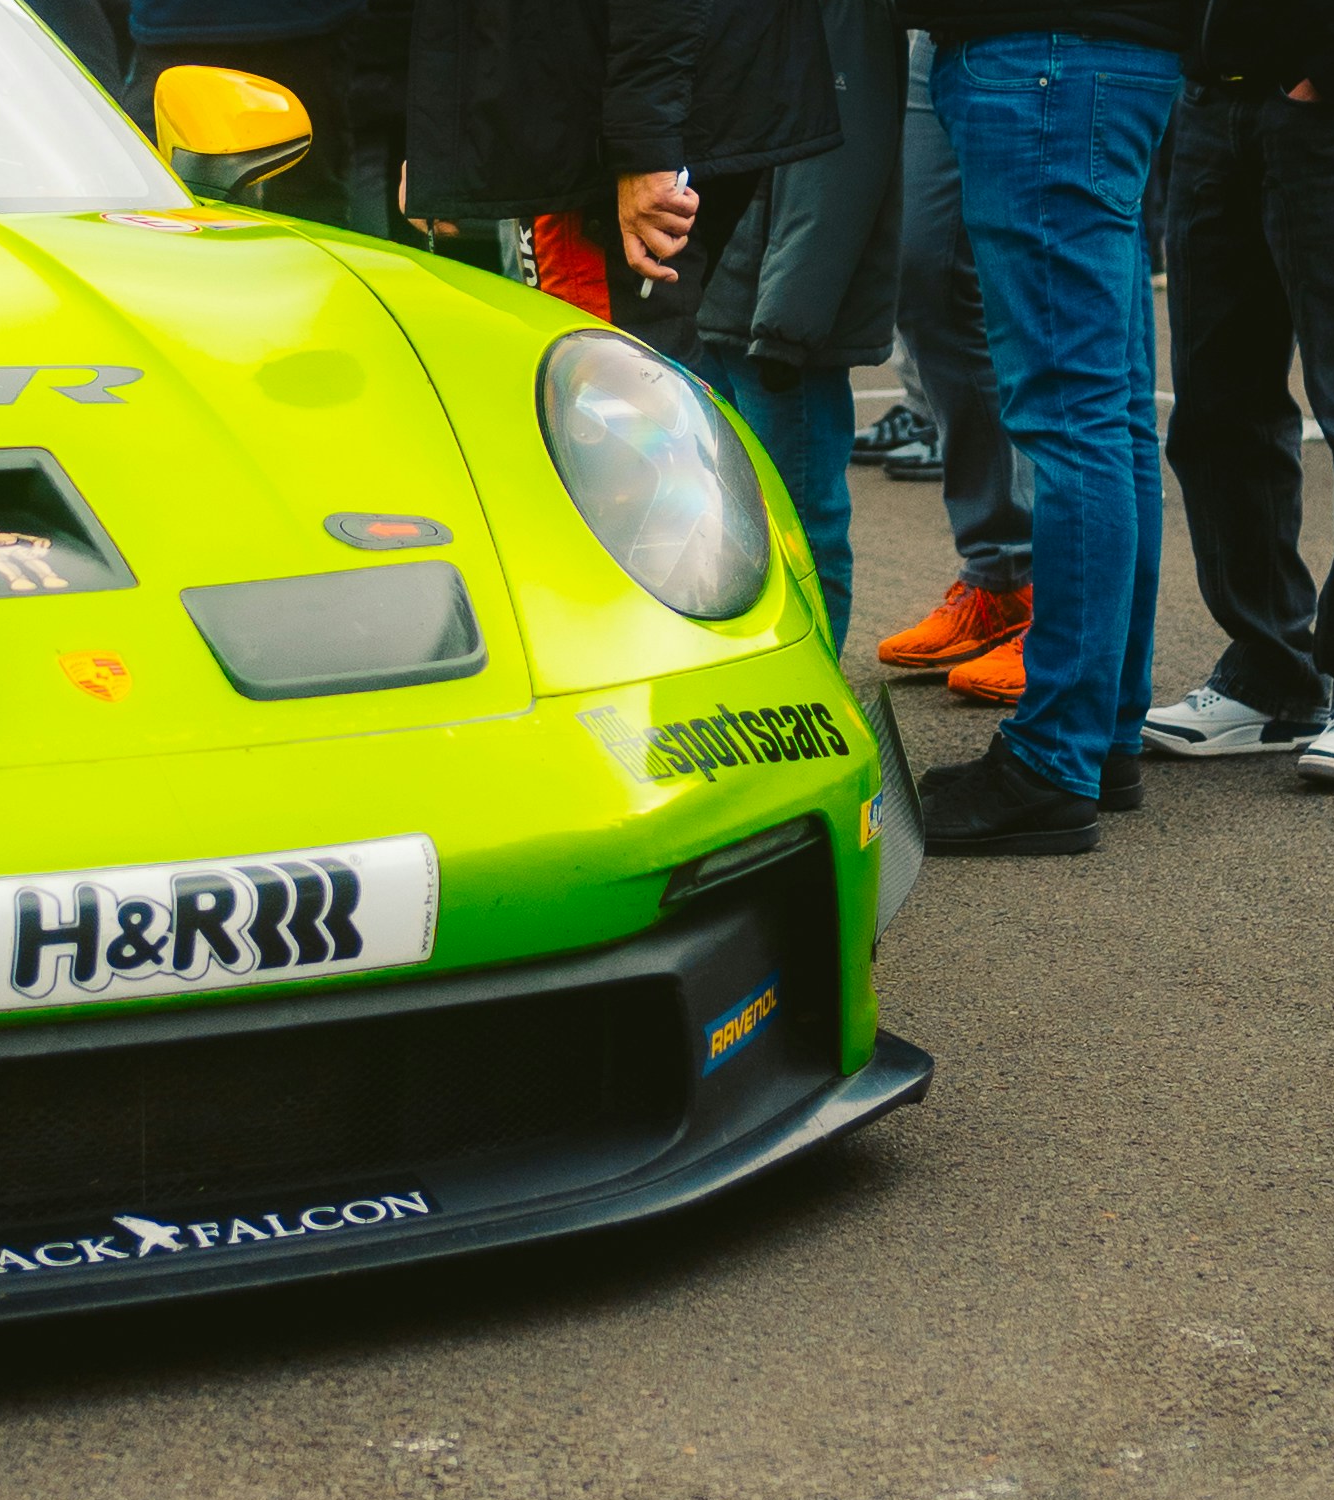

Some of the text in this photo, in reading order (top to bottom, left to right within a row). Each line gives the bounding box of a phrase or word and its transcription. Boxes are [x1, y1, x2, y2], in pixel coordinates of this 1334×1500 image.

[643, 701, 851, 783] sportscars
[13, 871, 247, 990] H&R
[710, 984, 778, 1061] RAVENOL
[187, 1190, 430, 1248] FALCON
